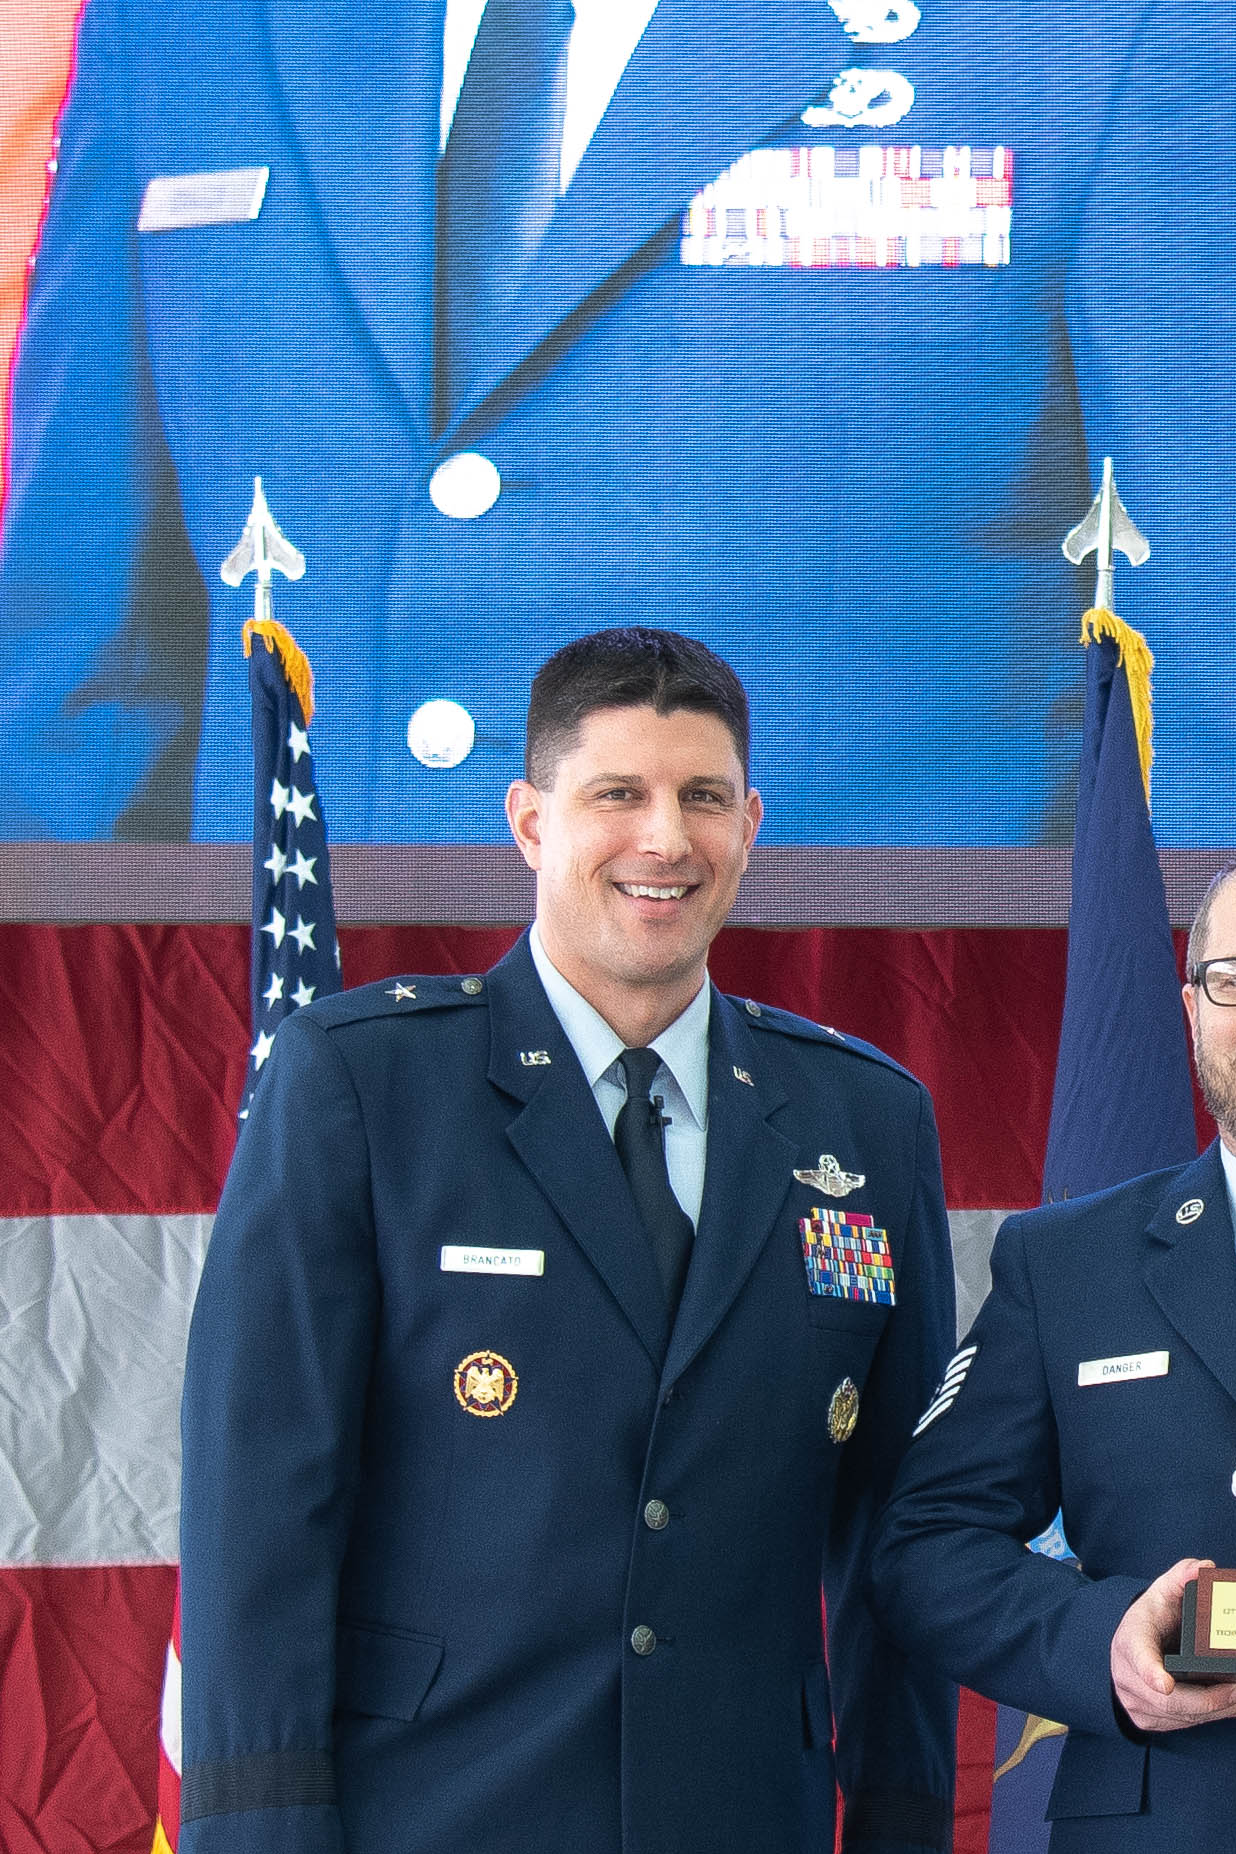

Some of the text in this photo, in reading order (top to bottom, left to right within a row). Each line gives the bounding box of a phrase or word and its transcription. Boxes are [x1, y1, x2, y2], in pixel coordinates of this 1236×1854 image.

[520, 1050, 552, 1066] US
[732, 1065, 755, 1087] US
[1102, 1361, 1142, 1376] DANGER
